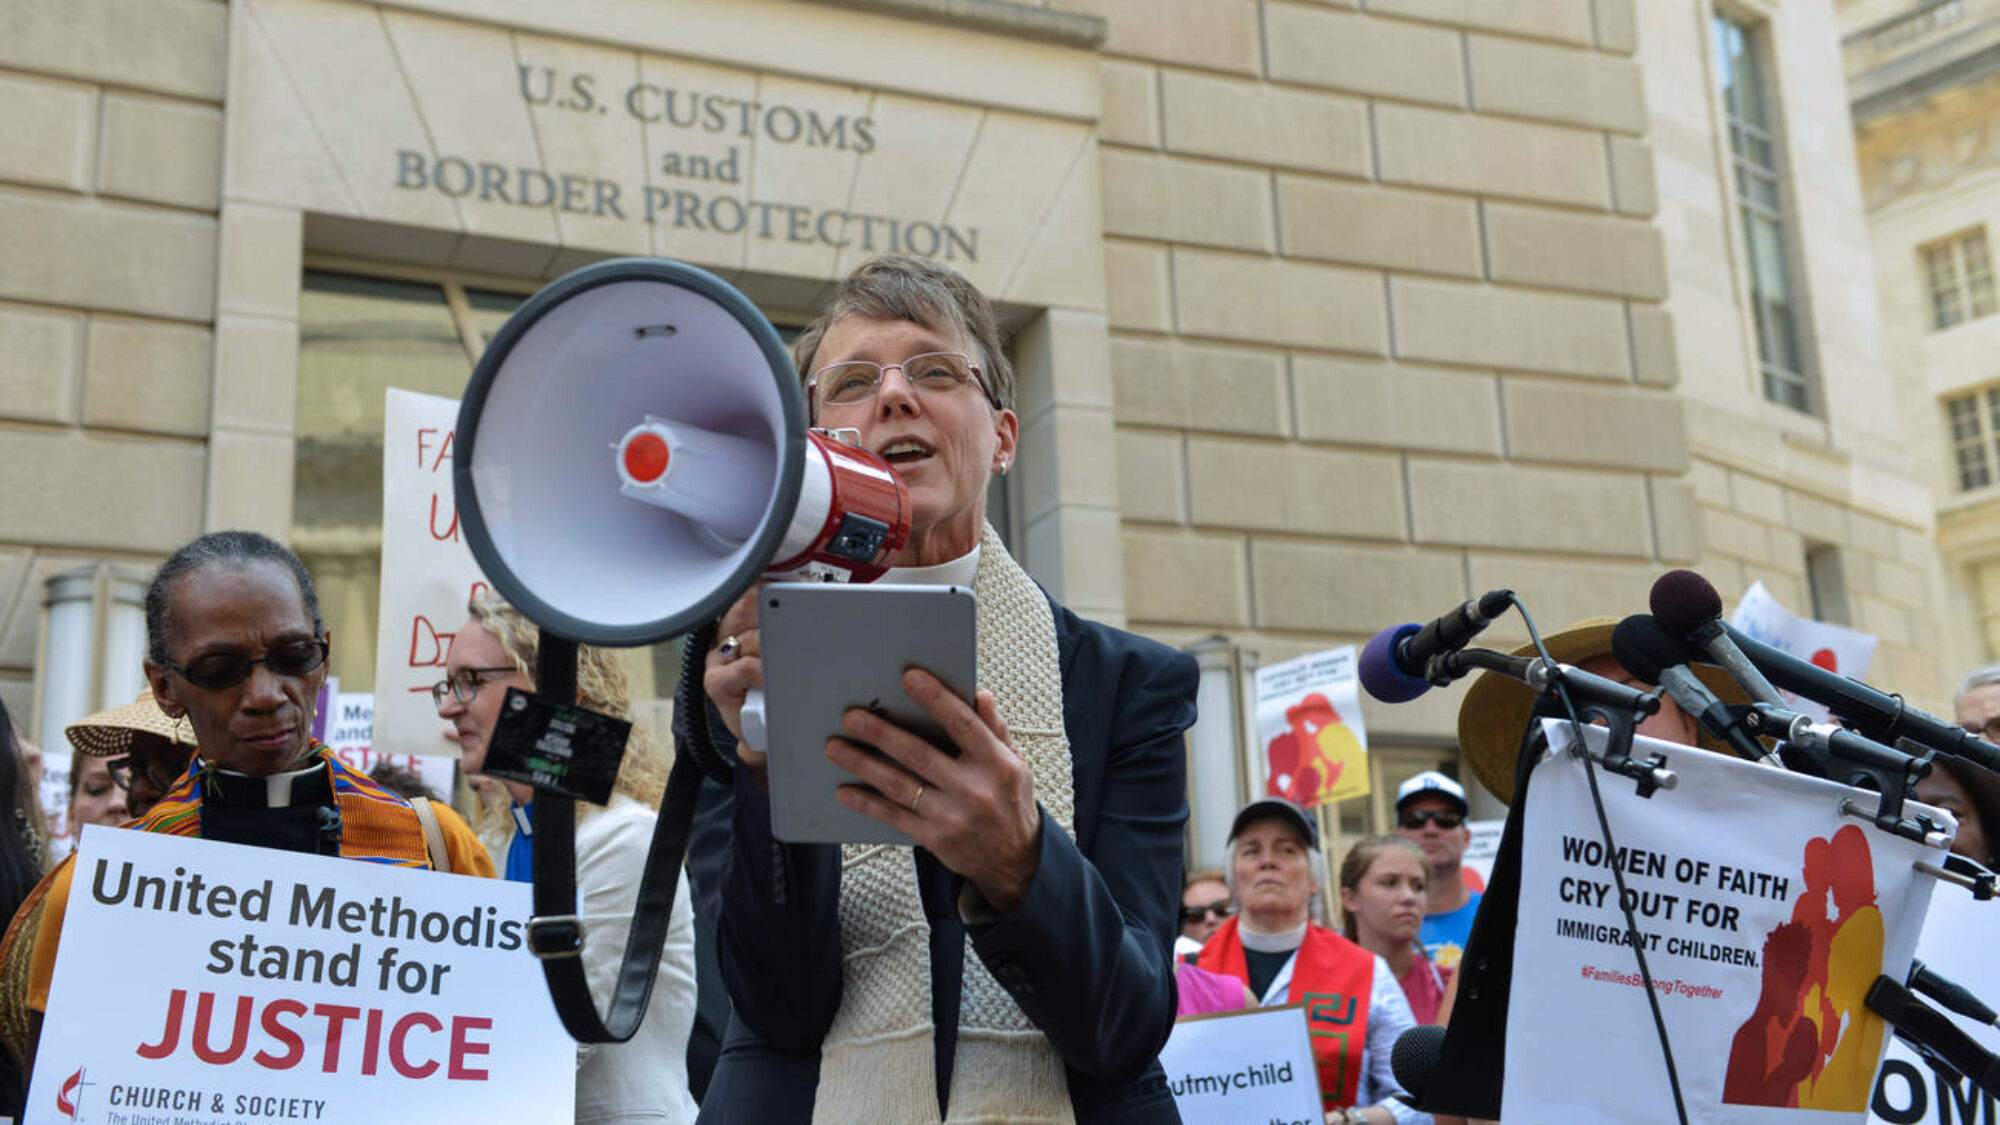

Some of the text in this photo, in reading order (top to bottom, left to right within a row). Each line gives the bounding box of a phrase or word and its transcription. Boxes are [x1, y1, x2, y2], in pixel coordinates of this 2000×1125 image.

[517, 64, 876, 154] U.S. CUSTOMS
[662, 147, 740, 184] and
[396, 149, 979, 262] BORDER PROTECTION
[1562, 835, 1789, 902] WOMEN OF FAITH
[91, 858, 531, 951] United Methodis
[1559, 876, 1740, 932] CRY OUT FOR
[207, 934, 451, 996] stand for
[1556, 917, 1760, 969] IMMIGRANT CHILDREN.
[1581, 965, 1724, 1000] #FamiliesBeongTogether
[136, 989, 493, 1081] JUSTICE
[109, 1084, 327, 1120] CHURCH & SOCIETY
